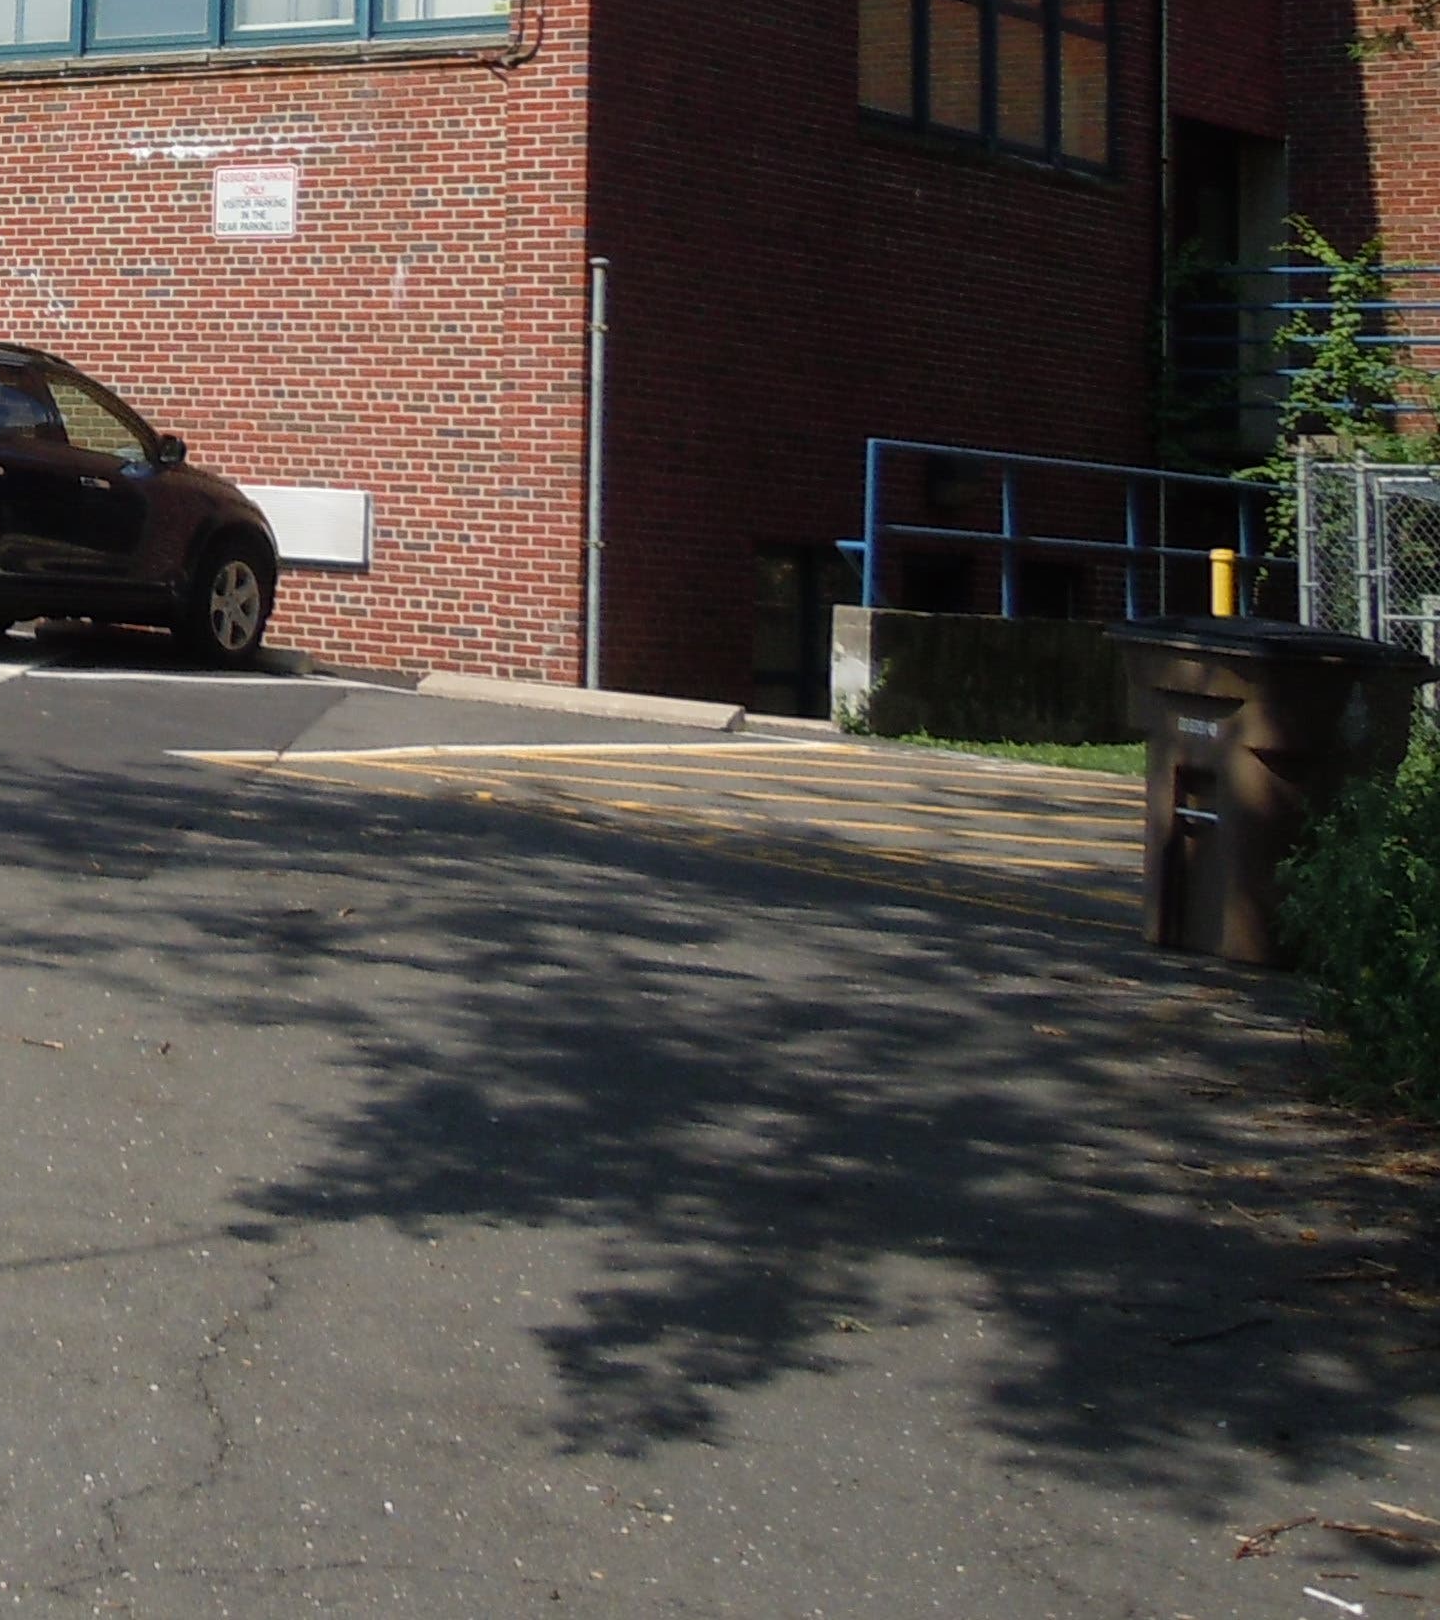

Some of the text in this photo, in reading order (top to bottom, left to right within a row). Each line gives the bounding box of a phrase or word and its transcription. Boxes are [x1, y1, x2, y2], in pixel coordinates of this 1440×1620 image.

[222, 198, 287, 209] VISITOR PARKING
[251, 210, 266, 219] THE
[240, 222, 273, 231] PARKING
